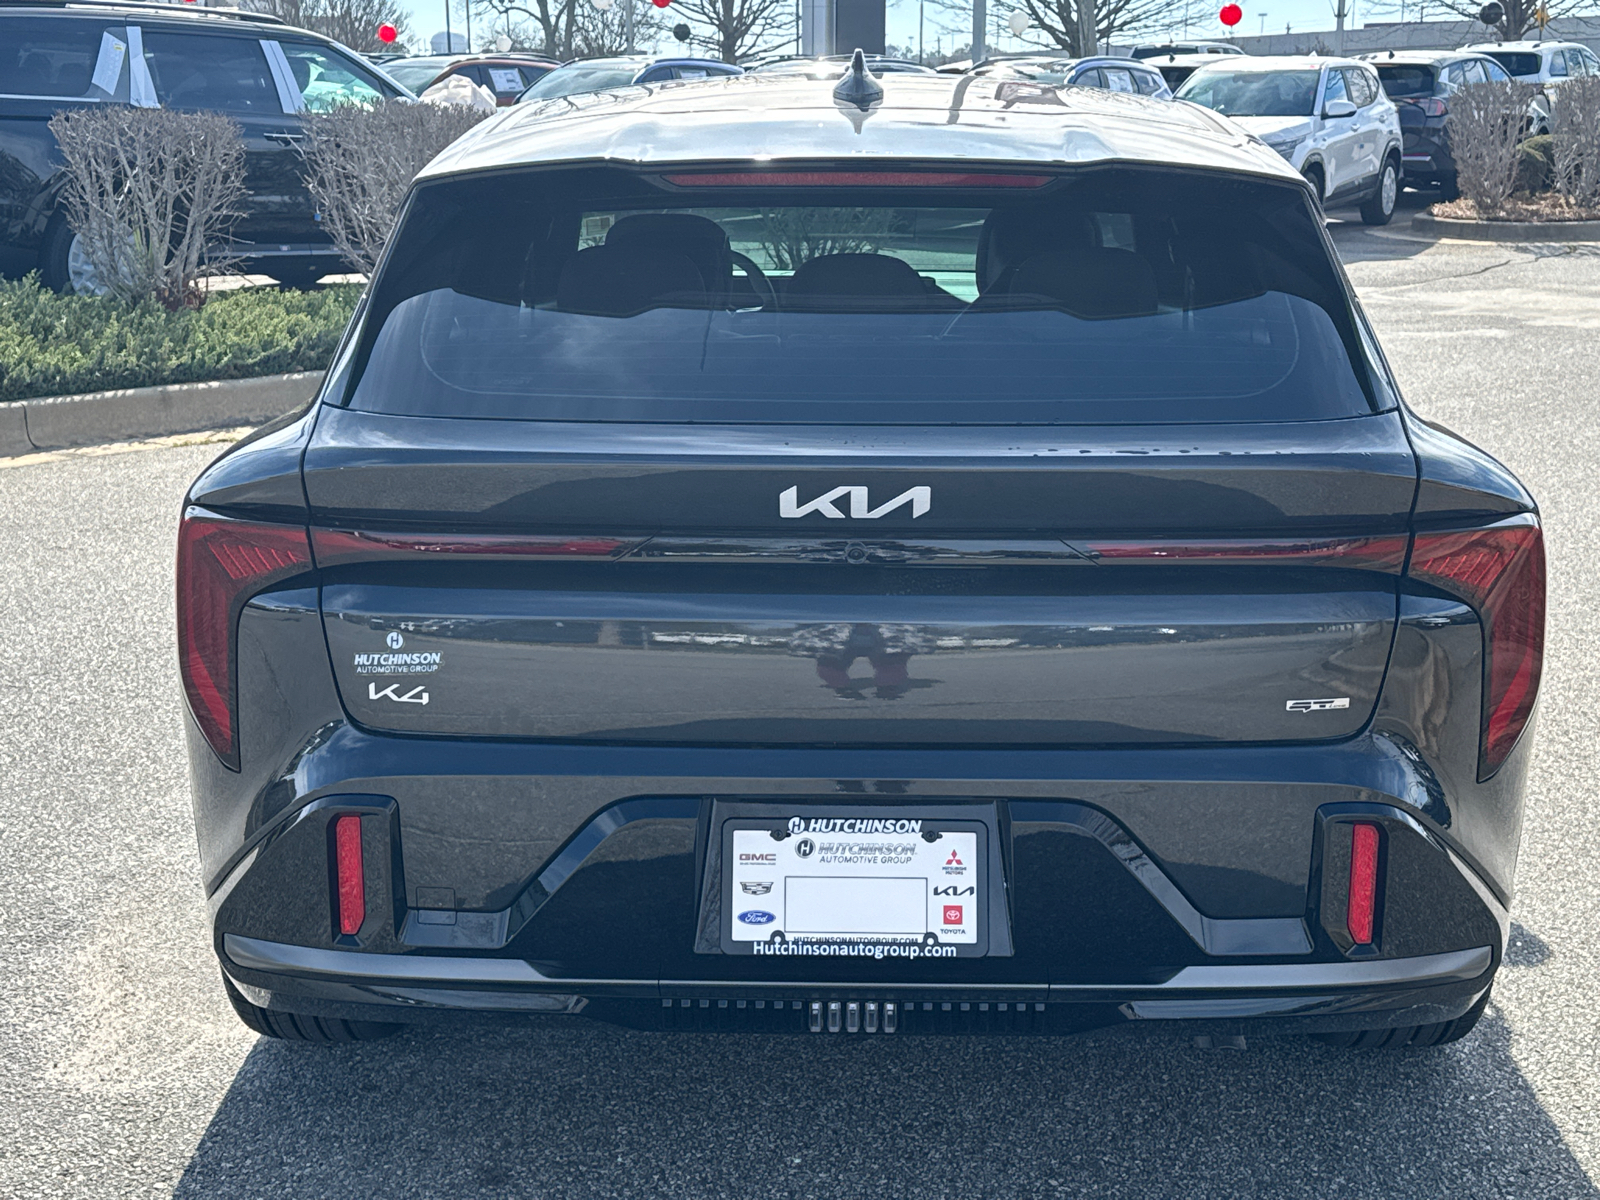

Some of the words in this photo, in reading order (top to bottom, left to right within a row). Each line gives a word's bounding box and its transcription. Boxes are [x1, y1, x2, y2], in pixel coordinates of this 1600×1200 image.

[779, 485, 931, 519] KIA
[354, 652, 441, 666] HUTCHINSON
[356, 665, 408, 673] AUTOMOTIVE
[409, 665, 438, 673] GROUP
[368, 682, 430, 705] K4
[808, 818, 922, 834] HUTCHINSON
[818, 842, 916, 855] HUTCHINSON
[739, 853, 777, 861] GMC
[819, 855, 879, 864] AUTOMOTIVE
[880, 856, 912, 865] GROUP
[933, 885, 975, 896] KIA
[753, 941, 957, 960] Hutchinsonautogroup.com
